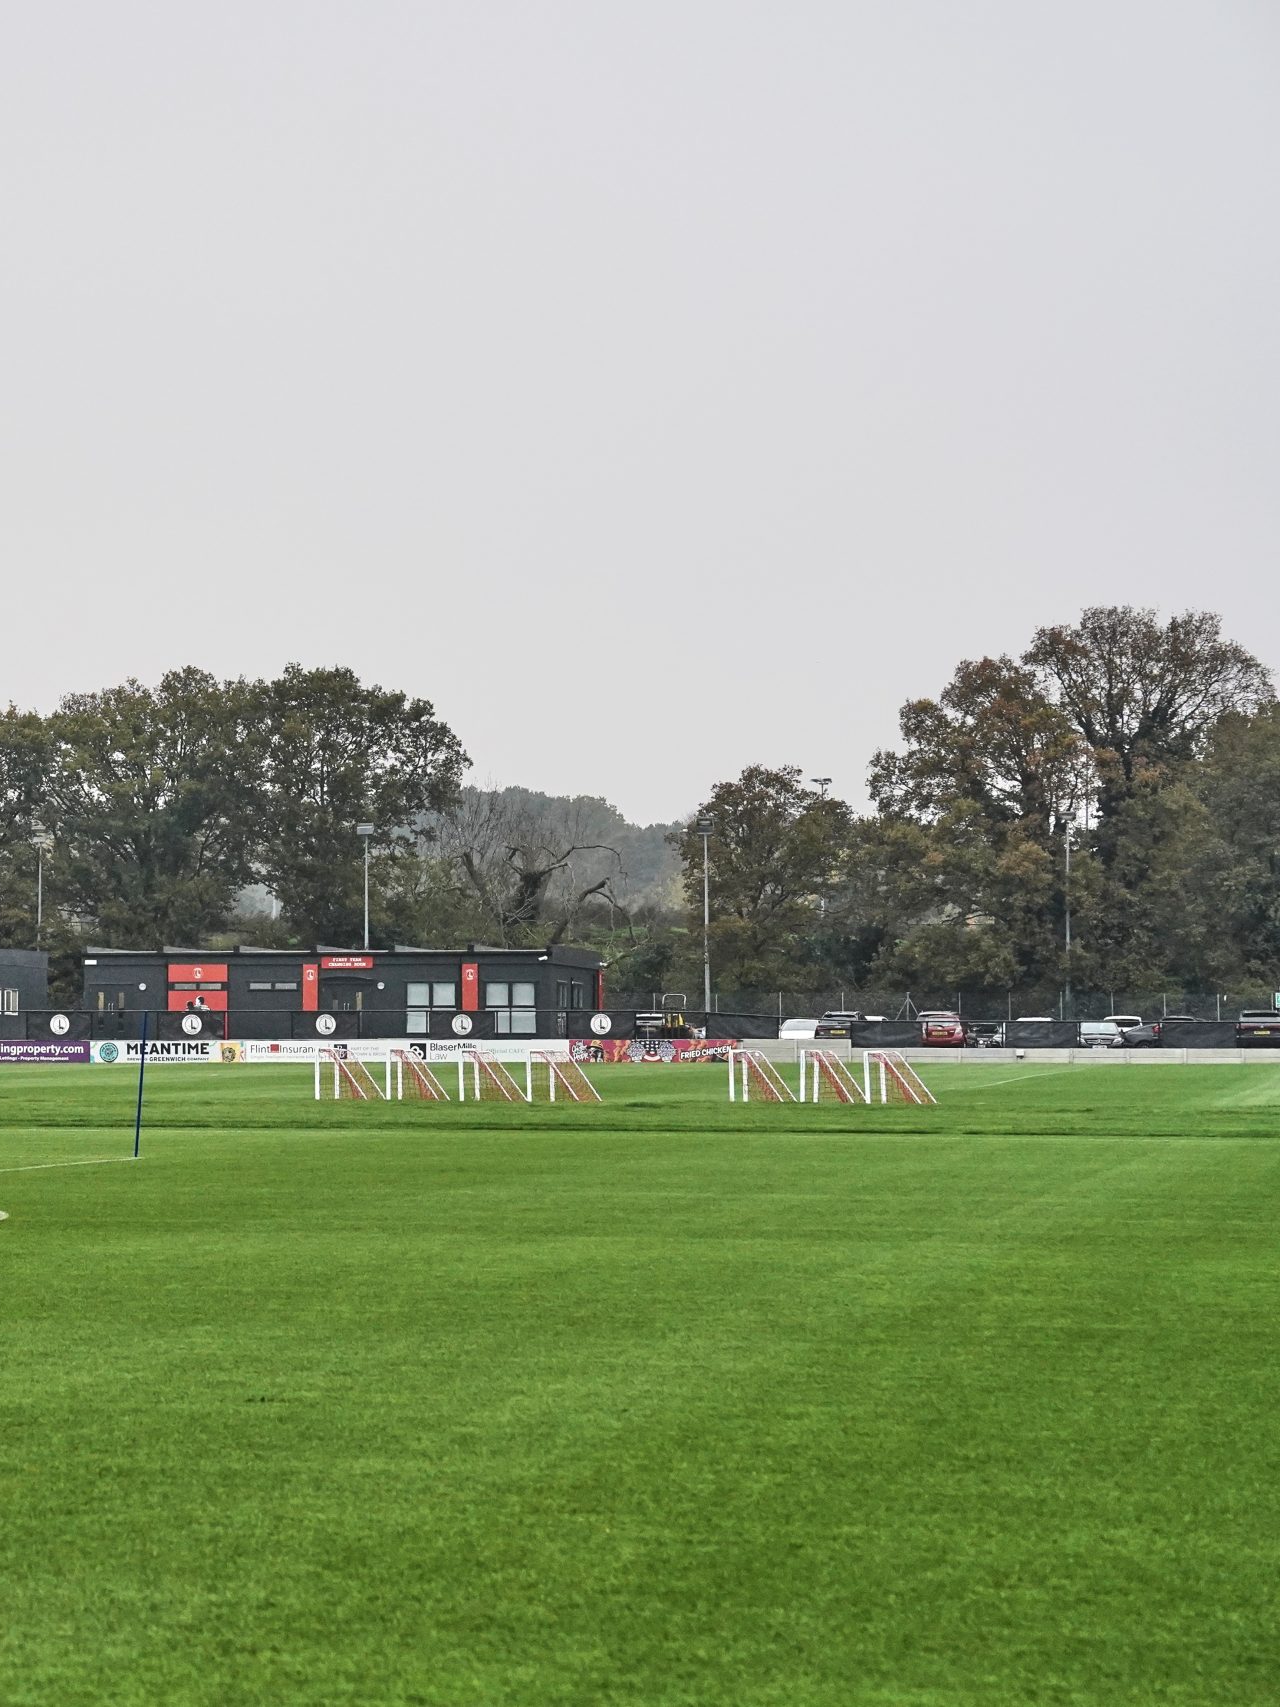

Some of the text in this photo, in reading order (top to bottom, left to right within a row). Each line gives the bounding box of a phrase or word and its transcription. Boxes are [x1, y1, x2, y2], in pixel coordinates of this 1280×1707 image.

[126, 1043, 210, 1055] MEANTIME
[250, 1043, 271, 1053] Flint
[679, 1049, 701, 1060] FRIED
[701, 1045, 732, 1057] CHICKEN
